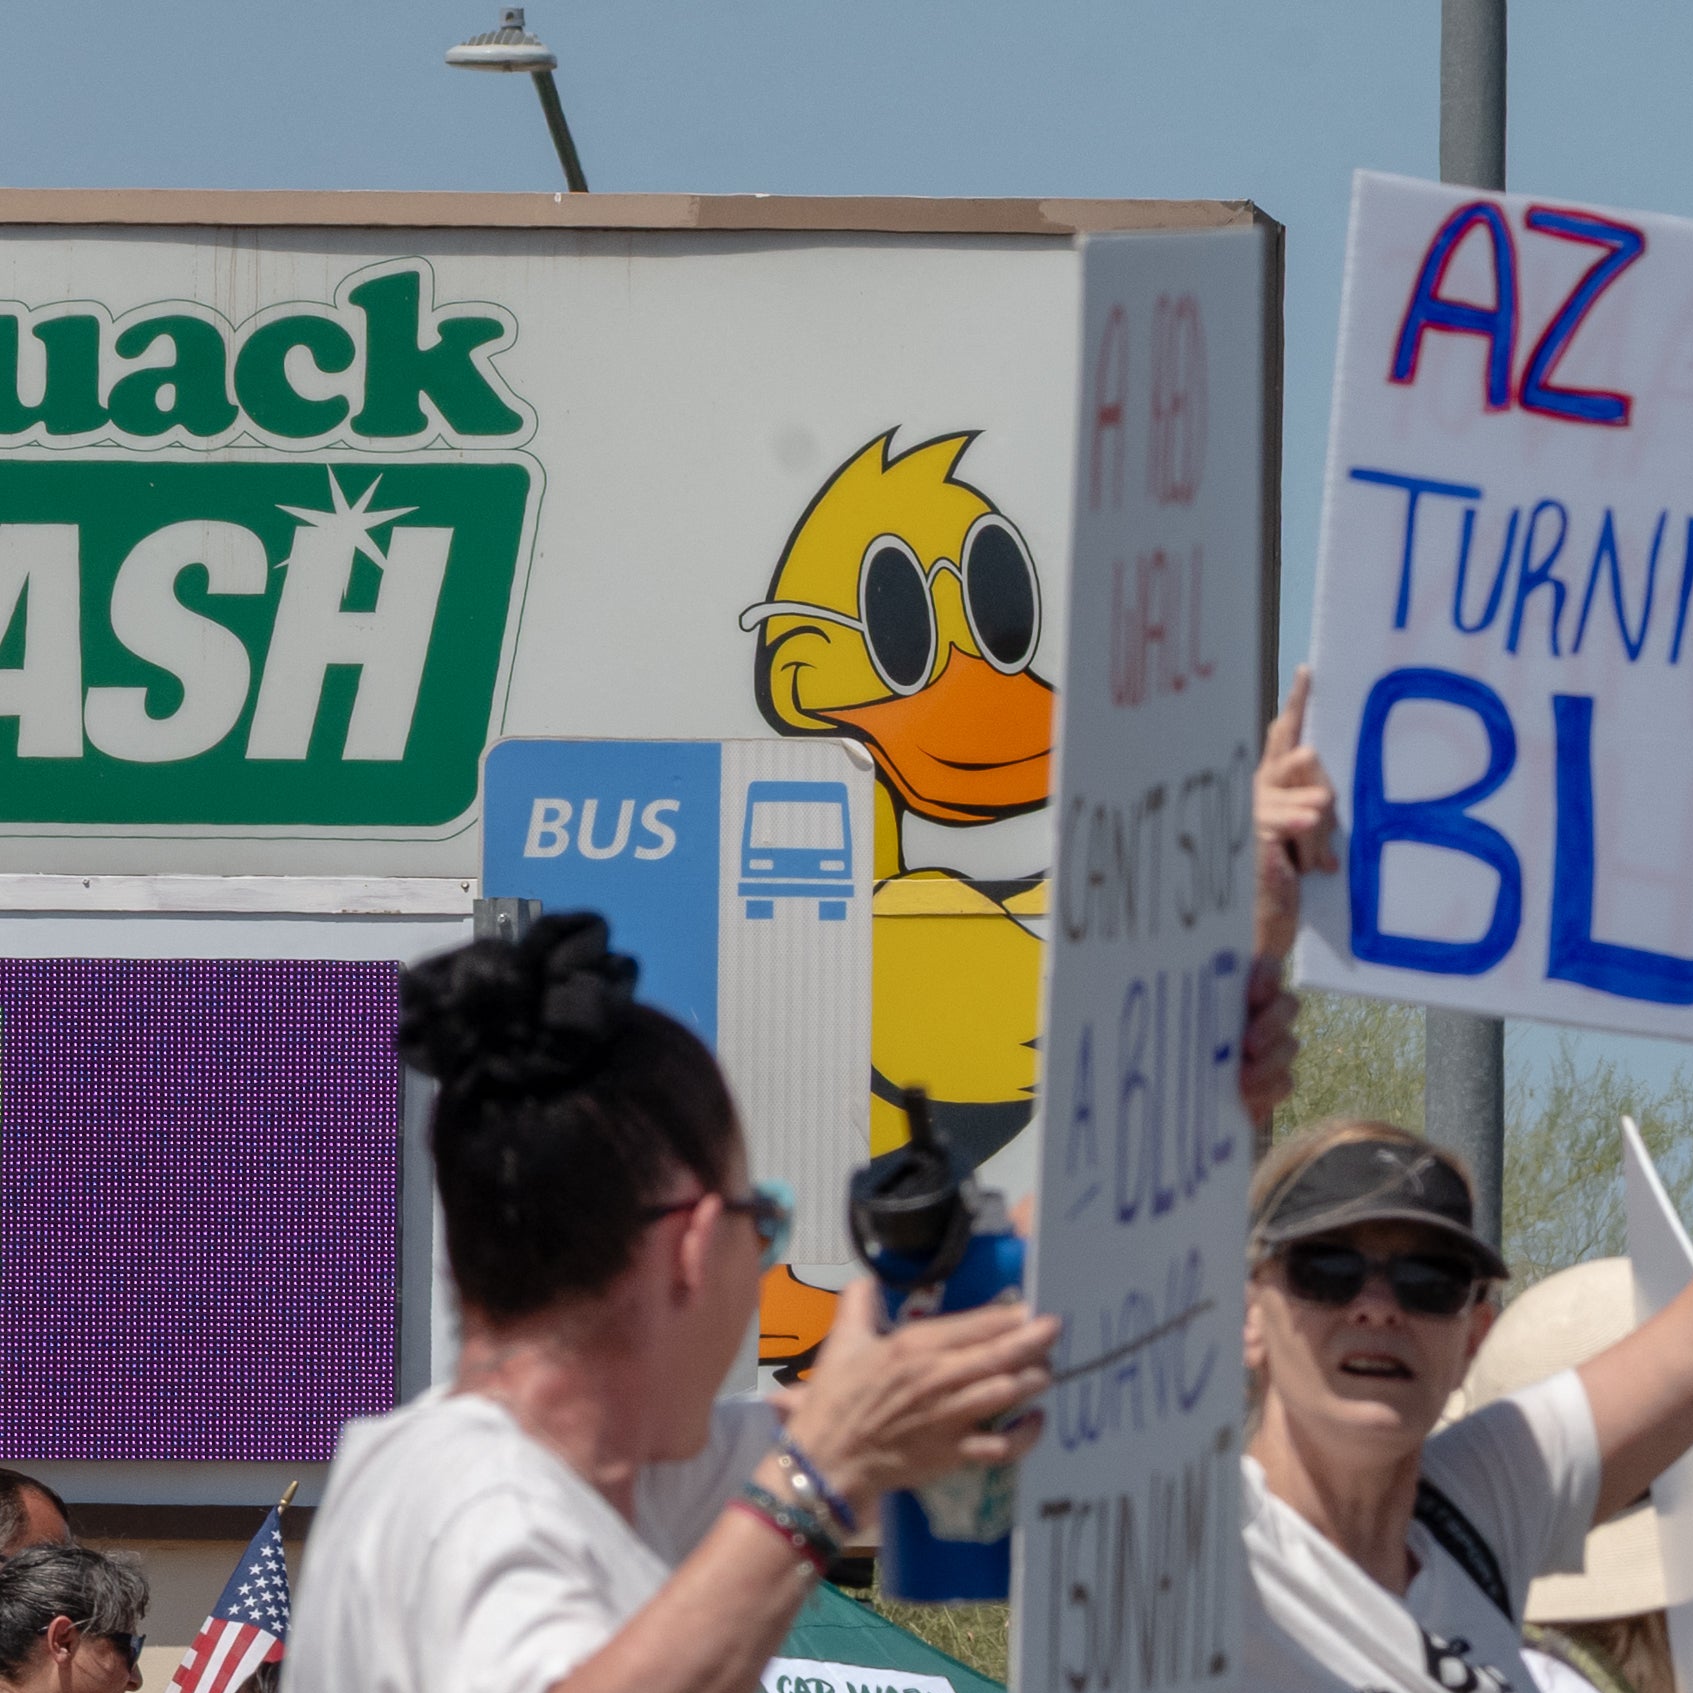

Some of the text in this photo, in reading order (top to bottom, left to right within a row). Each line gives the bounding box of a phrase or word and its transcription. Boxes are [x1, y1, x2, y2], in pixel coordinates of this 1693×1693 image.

[0, 266, 524, 437] uack
[1387, 199, 1646, 428] AZ
[0, 520, 454, 762] ASH
[523, 797, 680, 862] BUS
[1113, 950, 1238, 1226] BLUE
